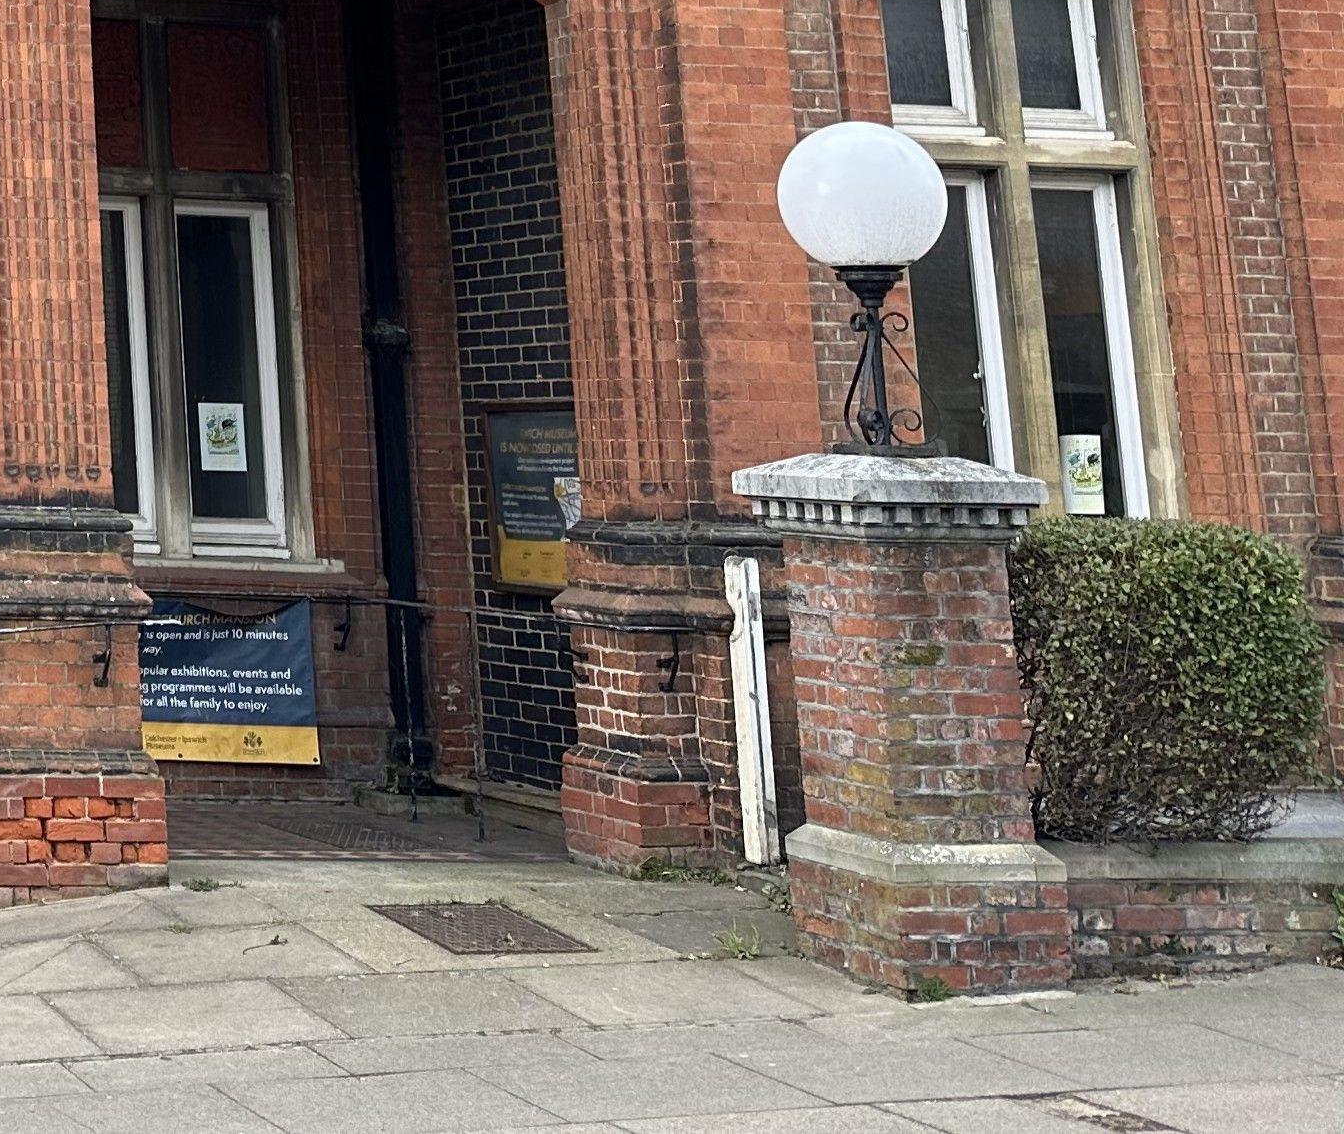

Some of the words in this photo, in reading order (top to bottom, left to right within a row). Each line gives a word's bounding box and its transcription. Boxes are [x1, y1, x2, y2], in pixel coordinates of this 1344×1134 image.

[213, 612, 277, 625] MANSION
[156, 631, 182, 642] open
[183, 629, 202, 640] and
[203, 628, 210, 640] is
[211, 629, 230, 642] just
[231, 628, 243, 639] 10
[245, 629, 289, 641] minutes
[171, 664, 230, 679] exhibitions,
[232, 668, 268, 679] events
[270, 668, 291, 680] and
[150, 683, 217, 695] programmes
[218, 682, 236, 694] will
[238, 682, 253, 694] be
[254, 683, 303, 696] available
[156, 695, 169, 707] all
[170, 696, 188, 708] the
[189, 696, 222, 712] family
[223, 699, 235, 709] to
[237, 699, 270, 713] enjoy.
